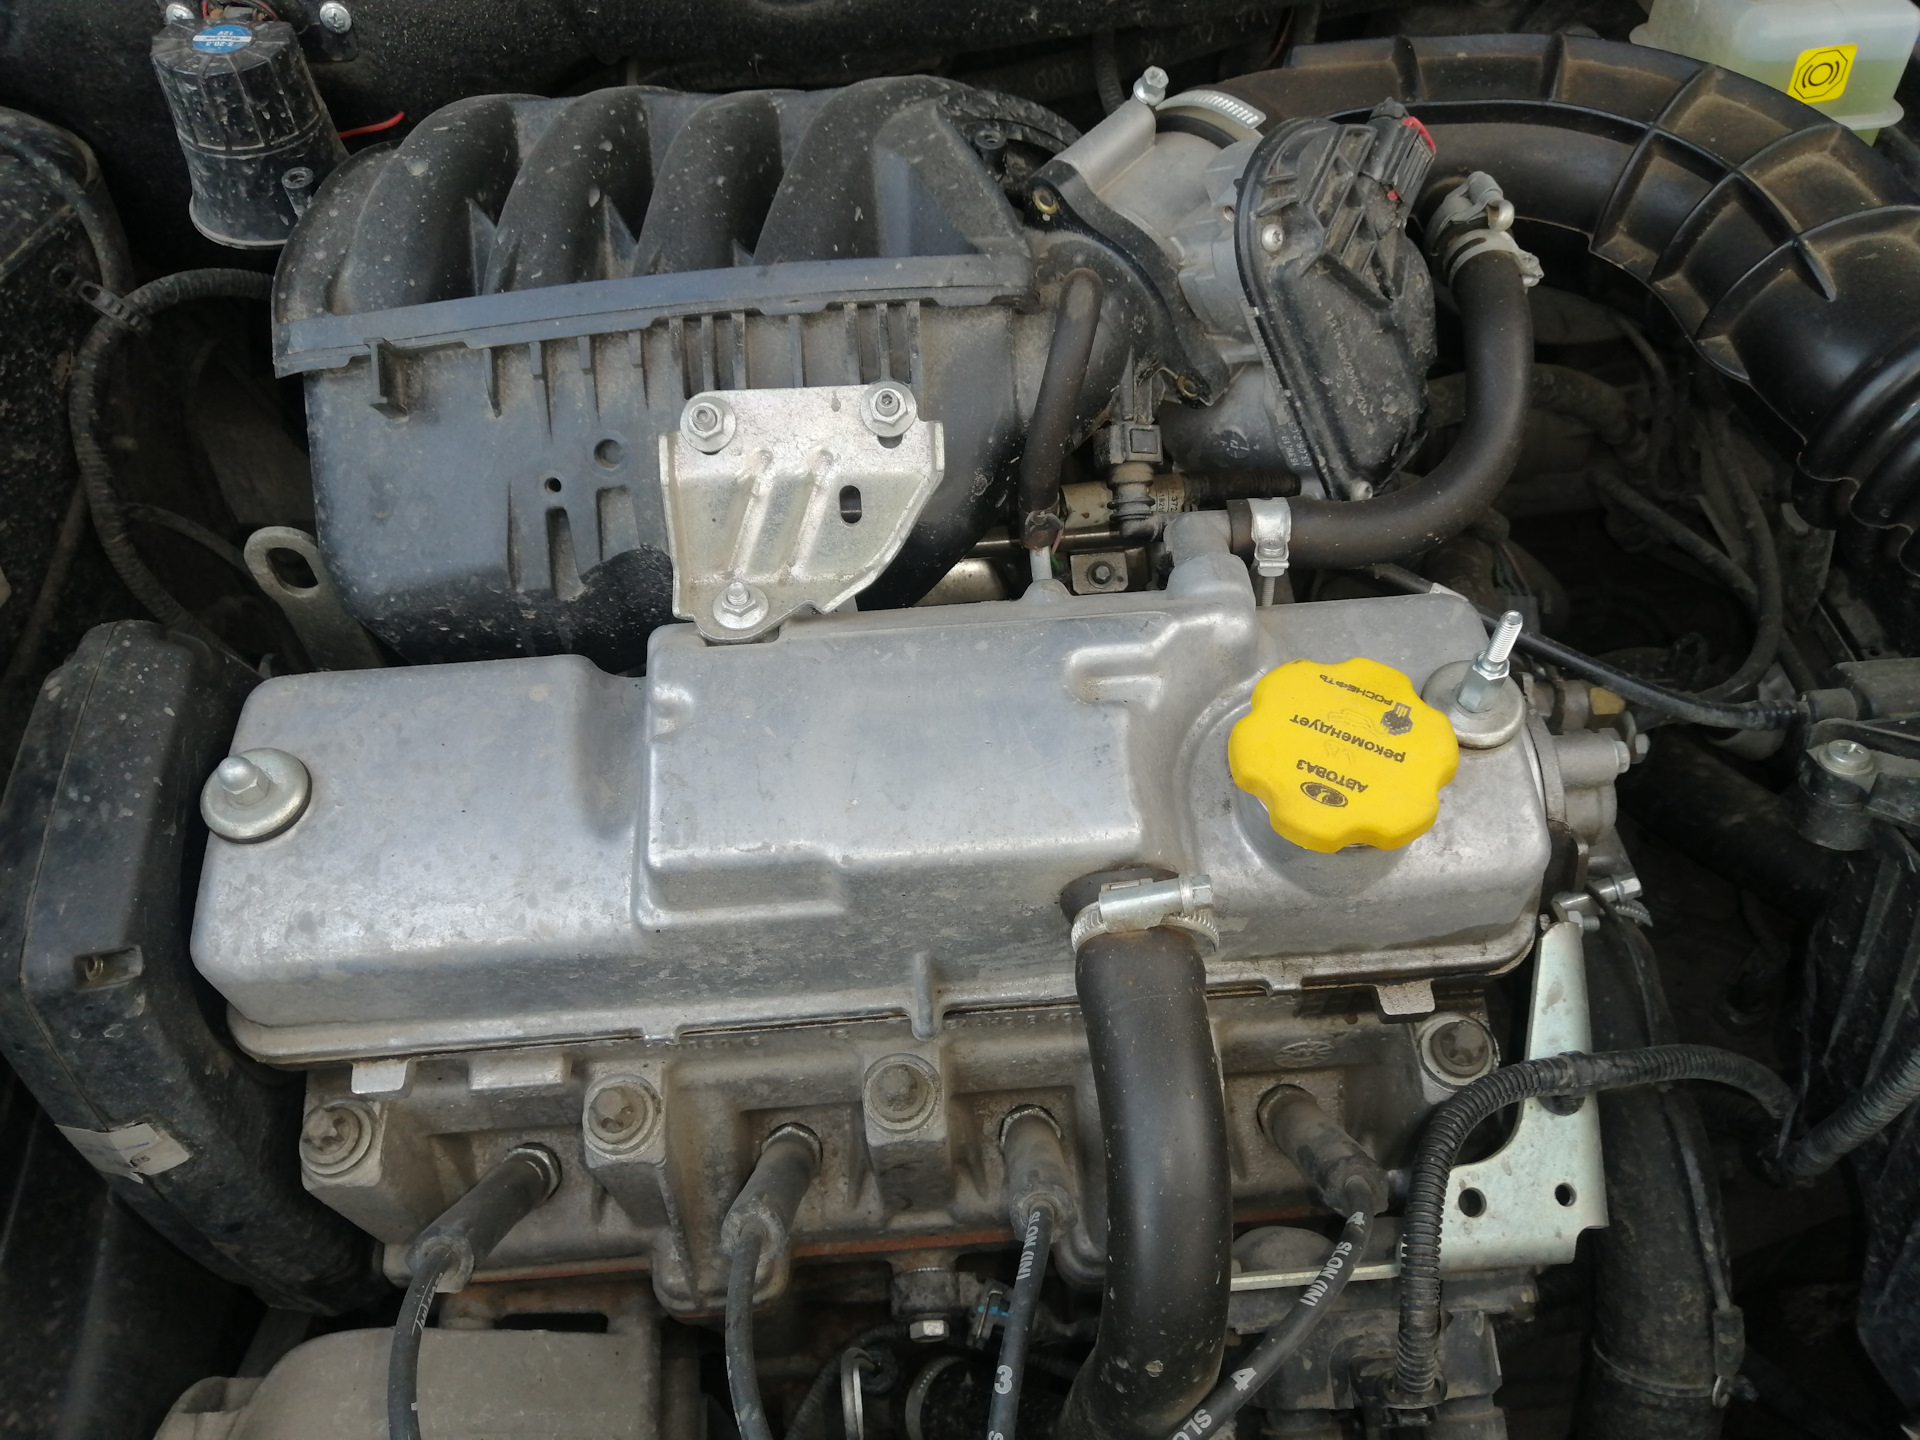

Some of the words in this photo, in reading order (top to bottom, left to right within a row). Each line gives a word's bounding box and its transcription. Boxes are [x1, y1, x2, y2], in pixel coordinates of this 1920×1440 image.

[1319, 674, 1393, 706] РОСНЕФТЬ
[1289, 714, 1407, 763] рекомендует
[1296, 759, 1369, 793] АВТОВАЗ
[1320, 1241, 1353, 1280] SLON
[994, 1364, 1013, 1395] 3
[1230, 1367, 1257, 1392] 4
